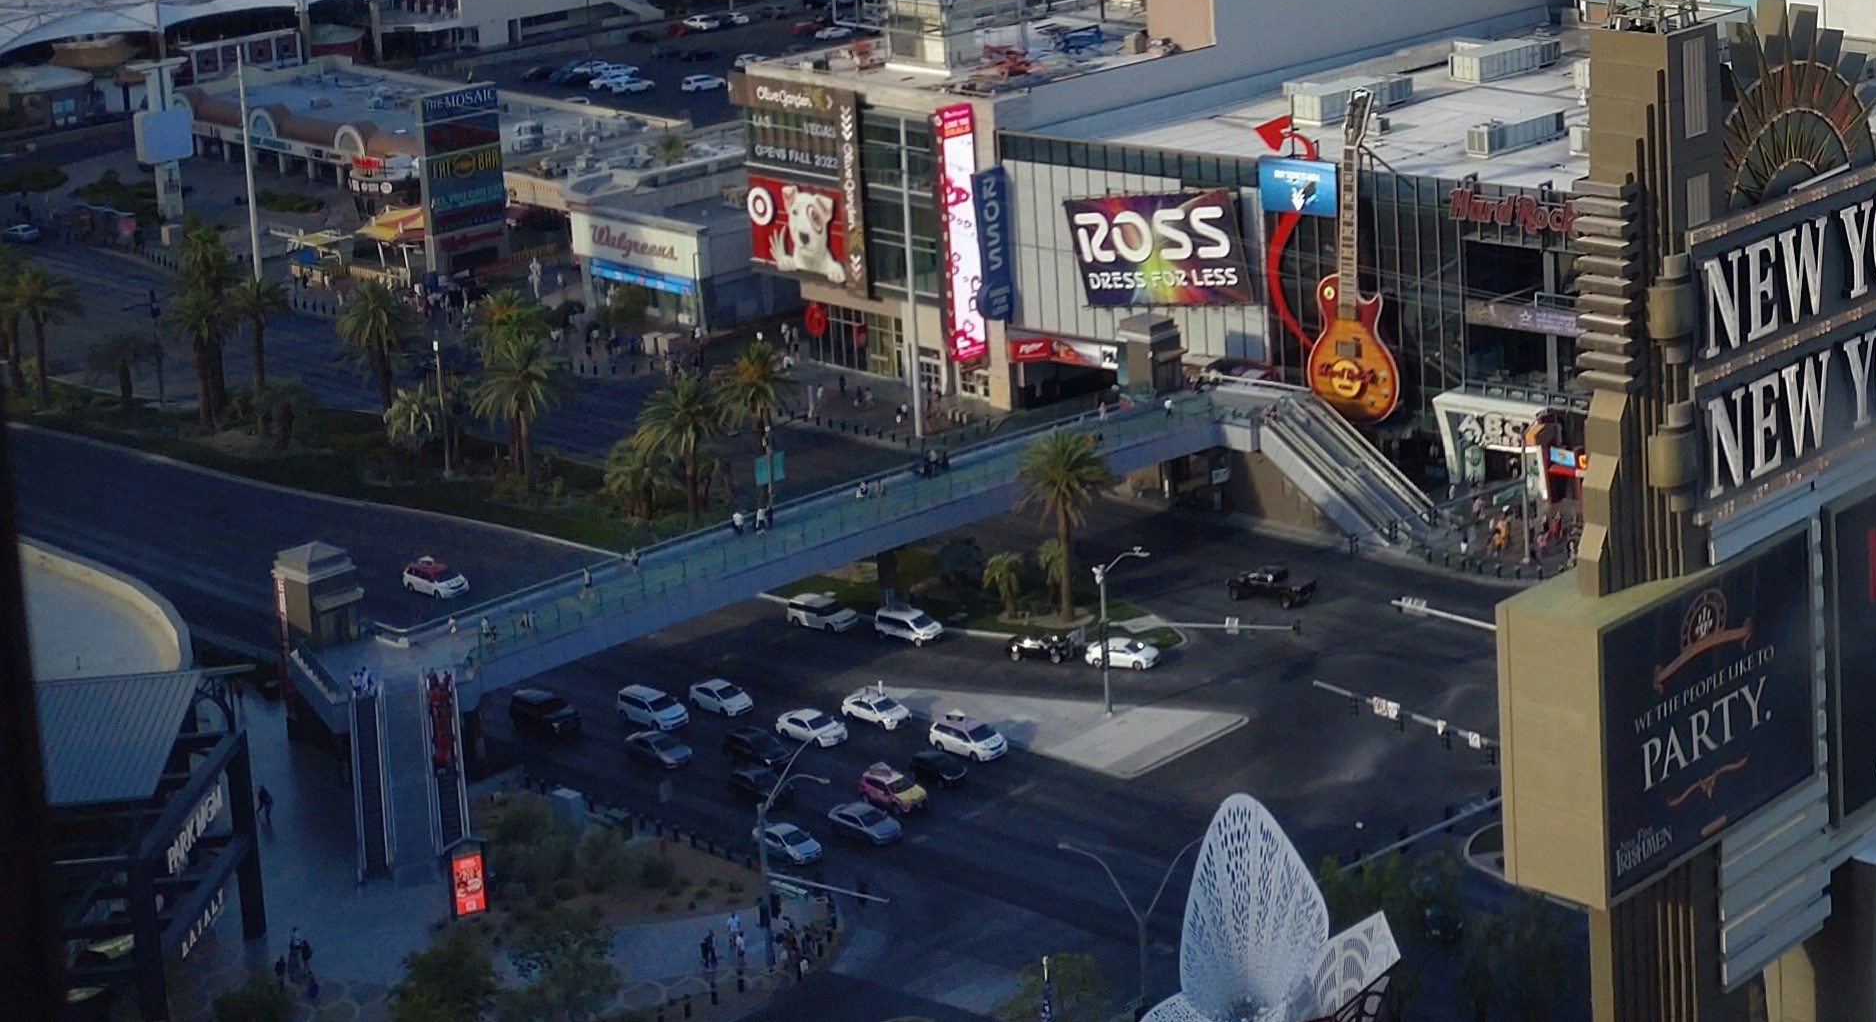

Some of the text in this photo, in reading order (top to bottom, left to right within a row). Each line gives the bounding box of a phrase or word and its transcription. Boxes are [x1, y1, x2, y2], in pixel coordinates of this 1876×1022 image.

[444, 87, 498, 109] MOSAIC
[756, 85, 813, 110] Olive Garden
[752, 114, 837, 139] LAS VEGAS
[477, 150, 499, 170] BAR
[755, 143, 839, 169] OPENS FALL 2022
[982, 175, 1003, 271] ROSS
[1074, 206, 1230, 263] ROSS
[1449, 188, 1579, 241] Hard Rock
[590, 223, 678, 261] Walgreens
[1088, 267, 1238, 290] DRESS FOR LESS
[1703, 216, 1828, 360] NEW
[1458, 412, 1524, 443] ABC
[1708, 350, 1831, 500] NEW
[1634, 644, 1775, 735] WE THE PEOPLE LIKE TO
[1640, 675, 1772, 793] PARTY.
[166, 783, 224, 875] PARK MGM
